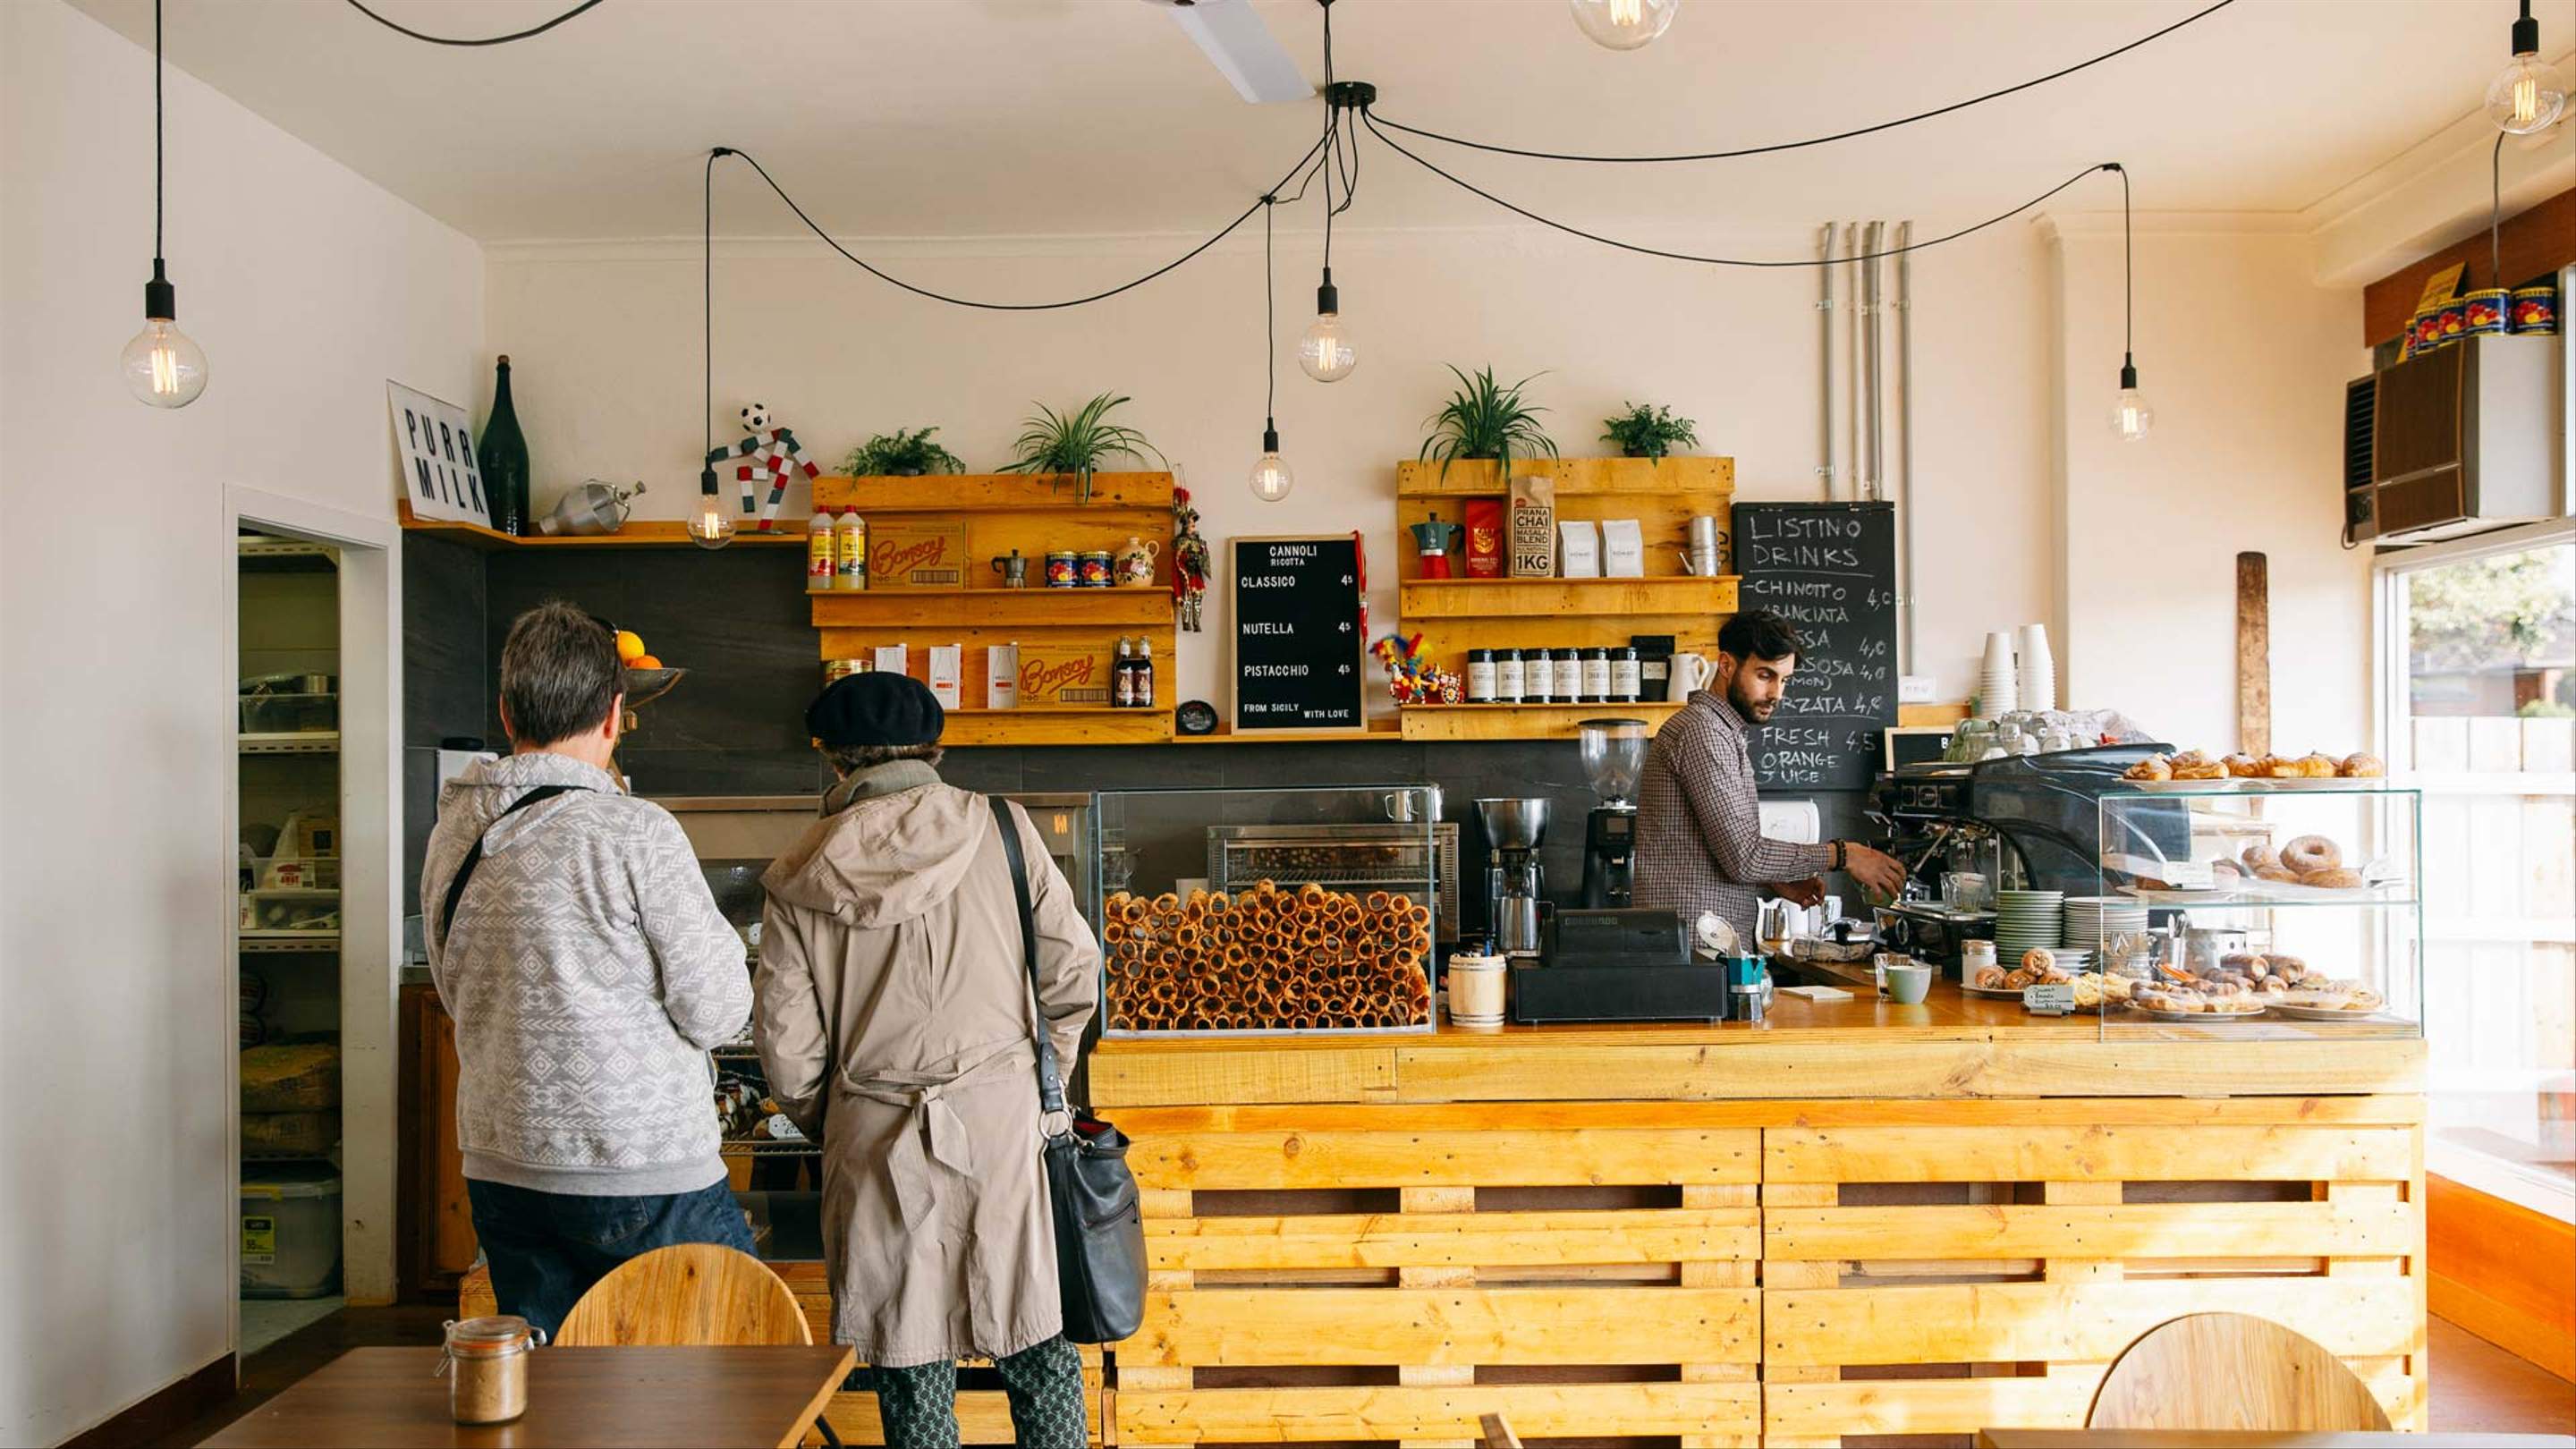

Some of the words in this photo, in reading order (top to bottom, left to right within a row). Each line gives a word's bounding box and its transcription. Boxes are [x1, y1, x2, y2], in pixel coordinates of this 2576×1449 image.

[405, 408, 473, 469] PURA
[415, 456, 485, 514] MILK
[1516, 516, 1548, 527] CHAI
[1750, 516, 1861, 539] LISTINO
[1269, 546, 1317, 557] CANNOLI
[1752, 545, 1859, 566] DRINKS
[1270, 558, 1305, 566] RICOTTA
[1516, 555, 1548, 570] 1KG
[1241, 576, 1296, 588] CLASSICO
[1242, 623, 1294, 634] NUTELLA
[1794, 629, 1831, 648] SSA
[1244, 665, 1309, 677] PISTACCHIO
[1793, 657, 1854, 676] SOSA
[1244, 704, 1267, 712] FROM
[1271, 703, 1299, 712] SICILY
[1303, 710, 1325, 718] WITH
[1327, 709, 1349, 718] LOVE
[1782, 695, 1846, 713] RZATA
[1760, 726, 1830, 746] FRESH
[1846, 731, 1876, 754] 4,5
[1760, 750, 1840, 769] ORANGE
[1756, 768, 1820, 784] JUICE
